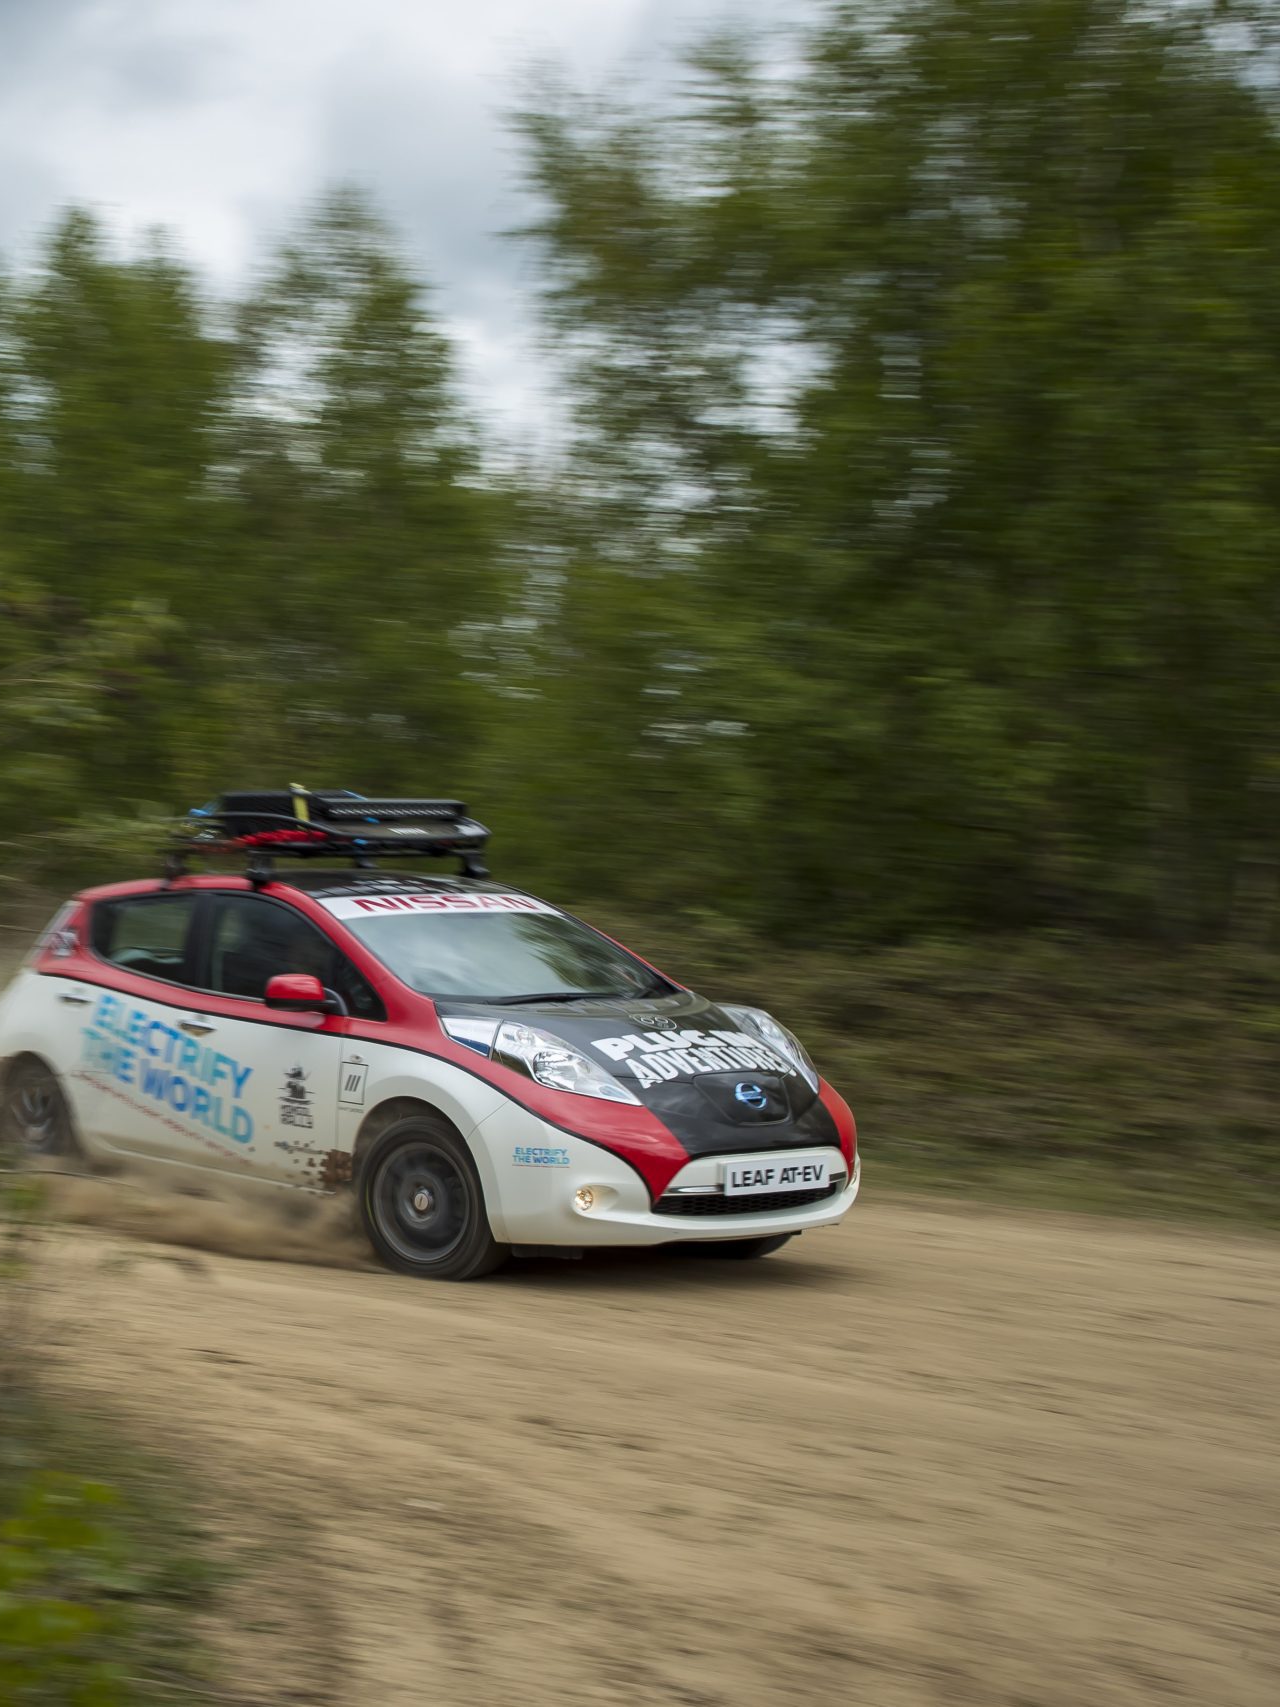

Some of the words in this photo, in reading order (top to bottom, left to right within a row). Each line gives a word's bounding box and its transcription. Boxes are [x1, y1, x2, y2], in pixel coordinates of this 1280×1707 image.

[352, 895, 539, 912] NISSAN
[93, 995, 254, 1098] ELECTRIFY
[591, 1029, 728, 1061] PLUG
[81, 1026, 137, 1084] THE
[139, 1058, 255, 1144] WORLD
[512, 1155, 531, 1163] THE
[532, 1156, 571, 1165] WORLD
[514, 1147, 568, 1156] ELECTRIFY
[731, 1168, 775, 1188] LEAF
[778, 1164, 824, 1184] AT-EV
